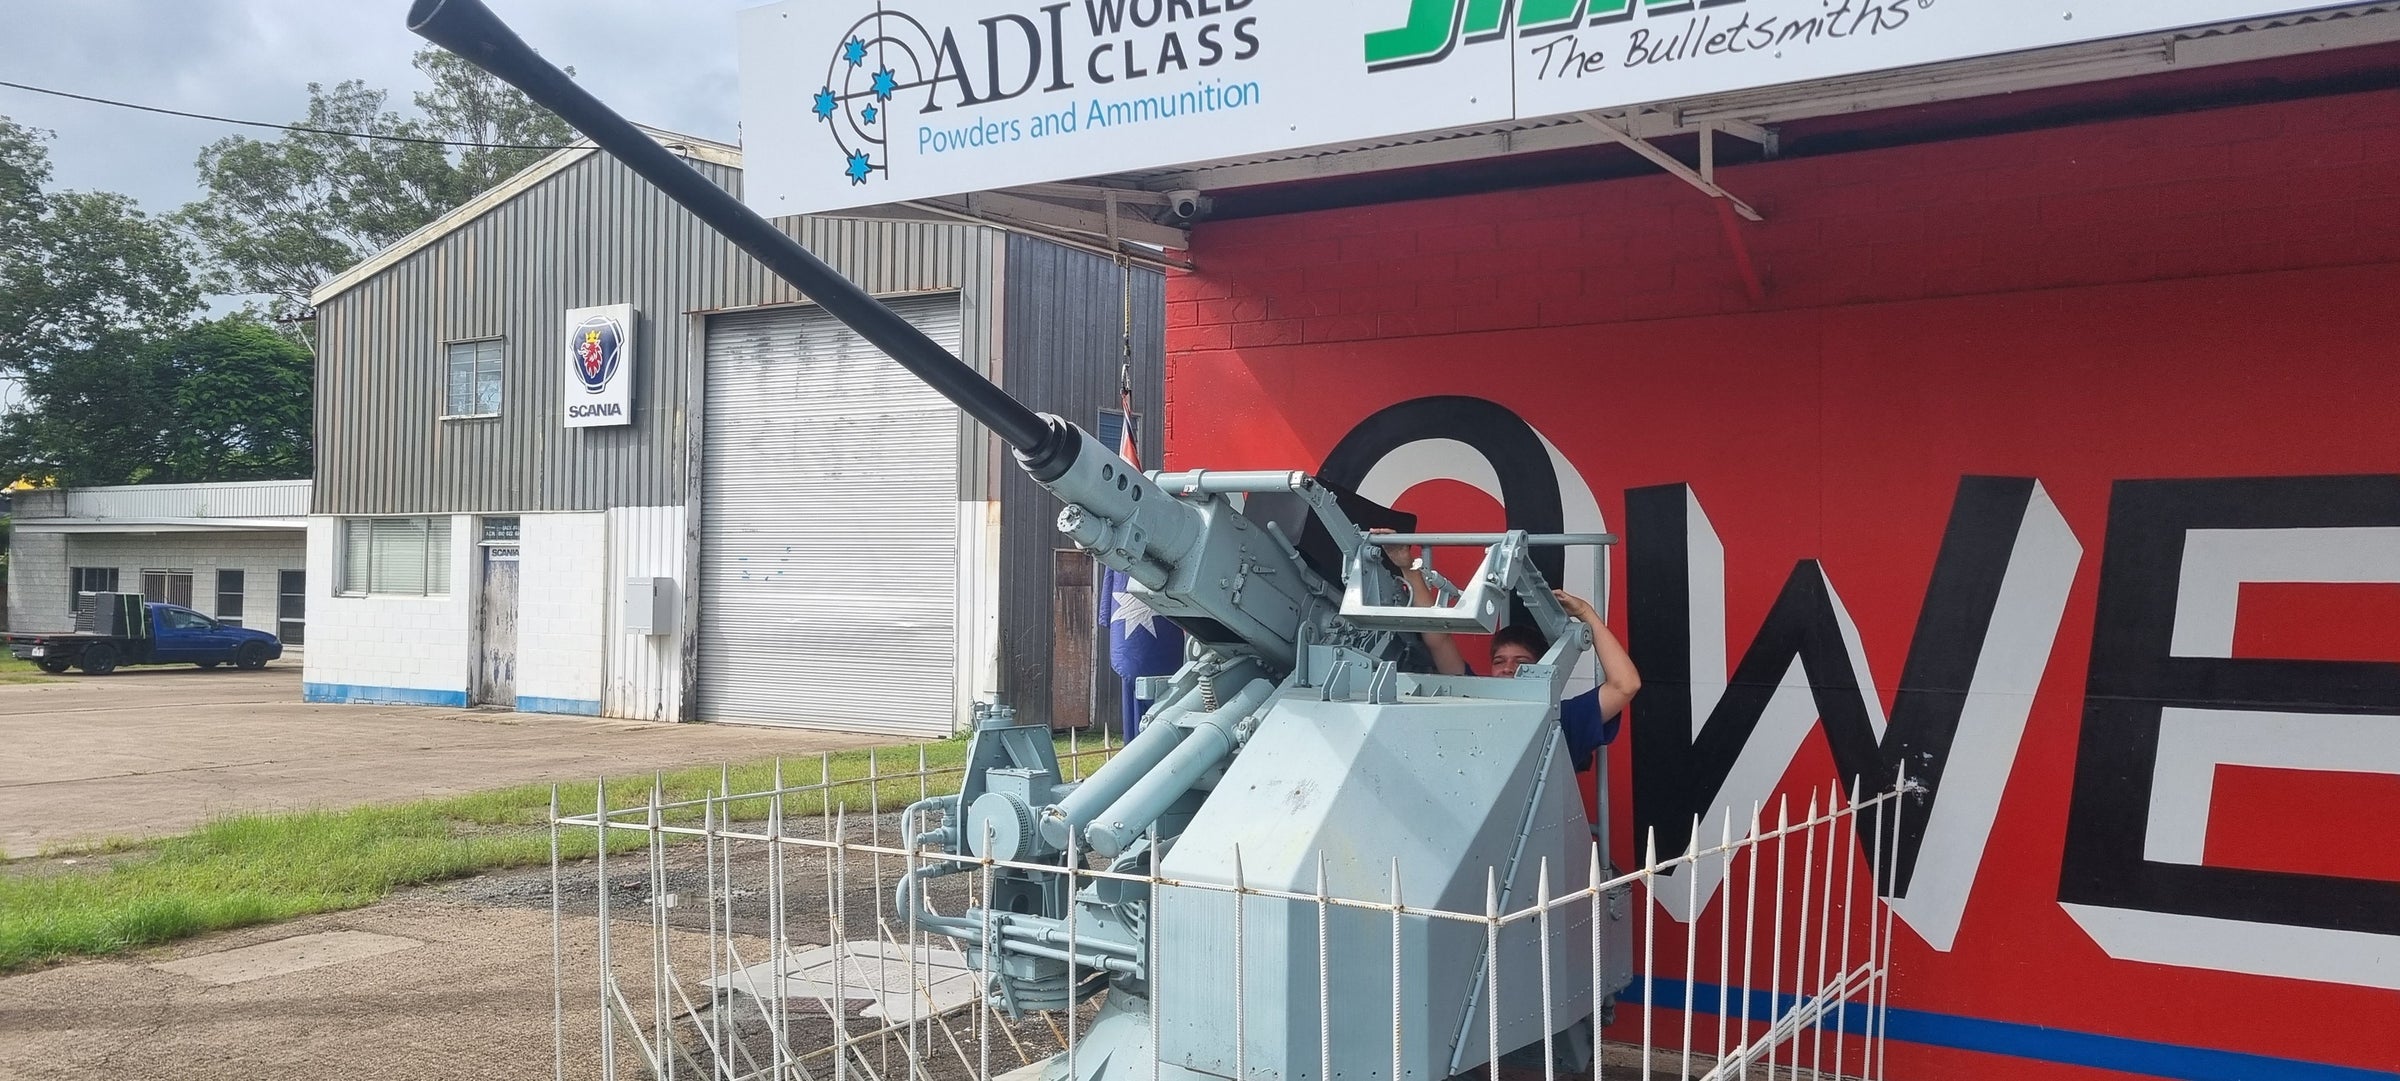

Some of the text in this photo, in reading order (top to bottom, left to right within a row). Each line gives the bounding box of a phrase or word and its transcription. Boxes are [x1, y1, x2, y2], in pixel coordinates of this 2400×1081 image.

[1084, 0, 1254, 37] WOR
[1087, 16, 1260, 85] CLASS
[1531, 34, 1605, 81] The
[1624, 0, 1910, 68] Bulletsmiths
[919, 2, 1075, 115] ADI
[919, 78, 1260, 155] Powders and Ammunition
[569, 403, 622, 418] SCANIA
[491, 548, 520, 557] SCANIA
